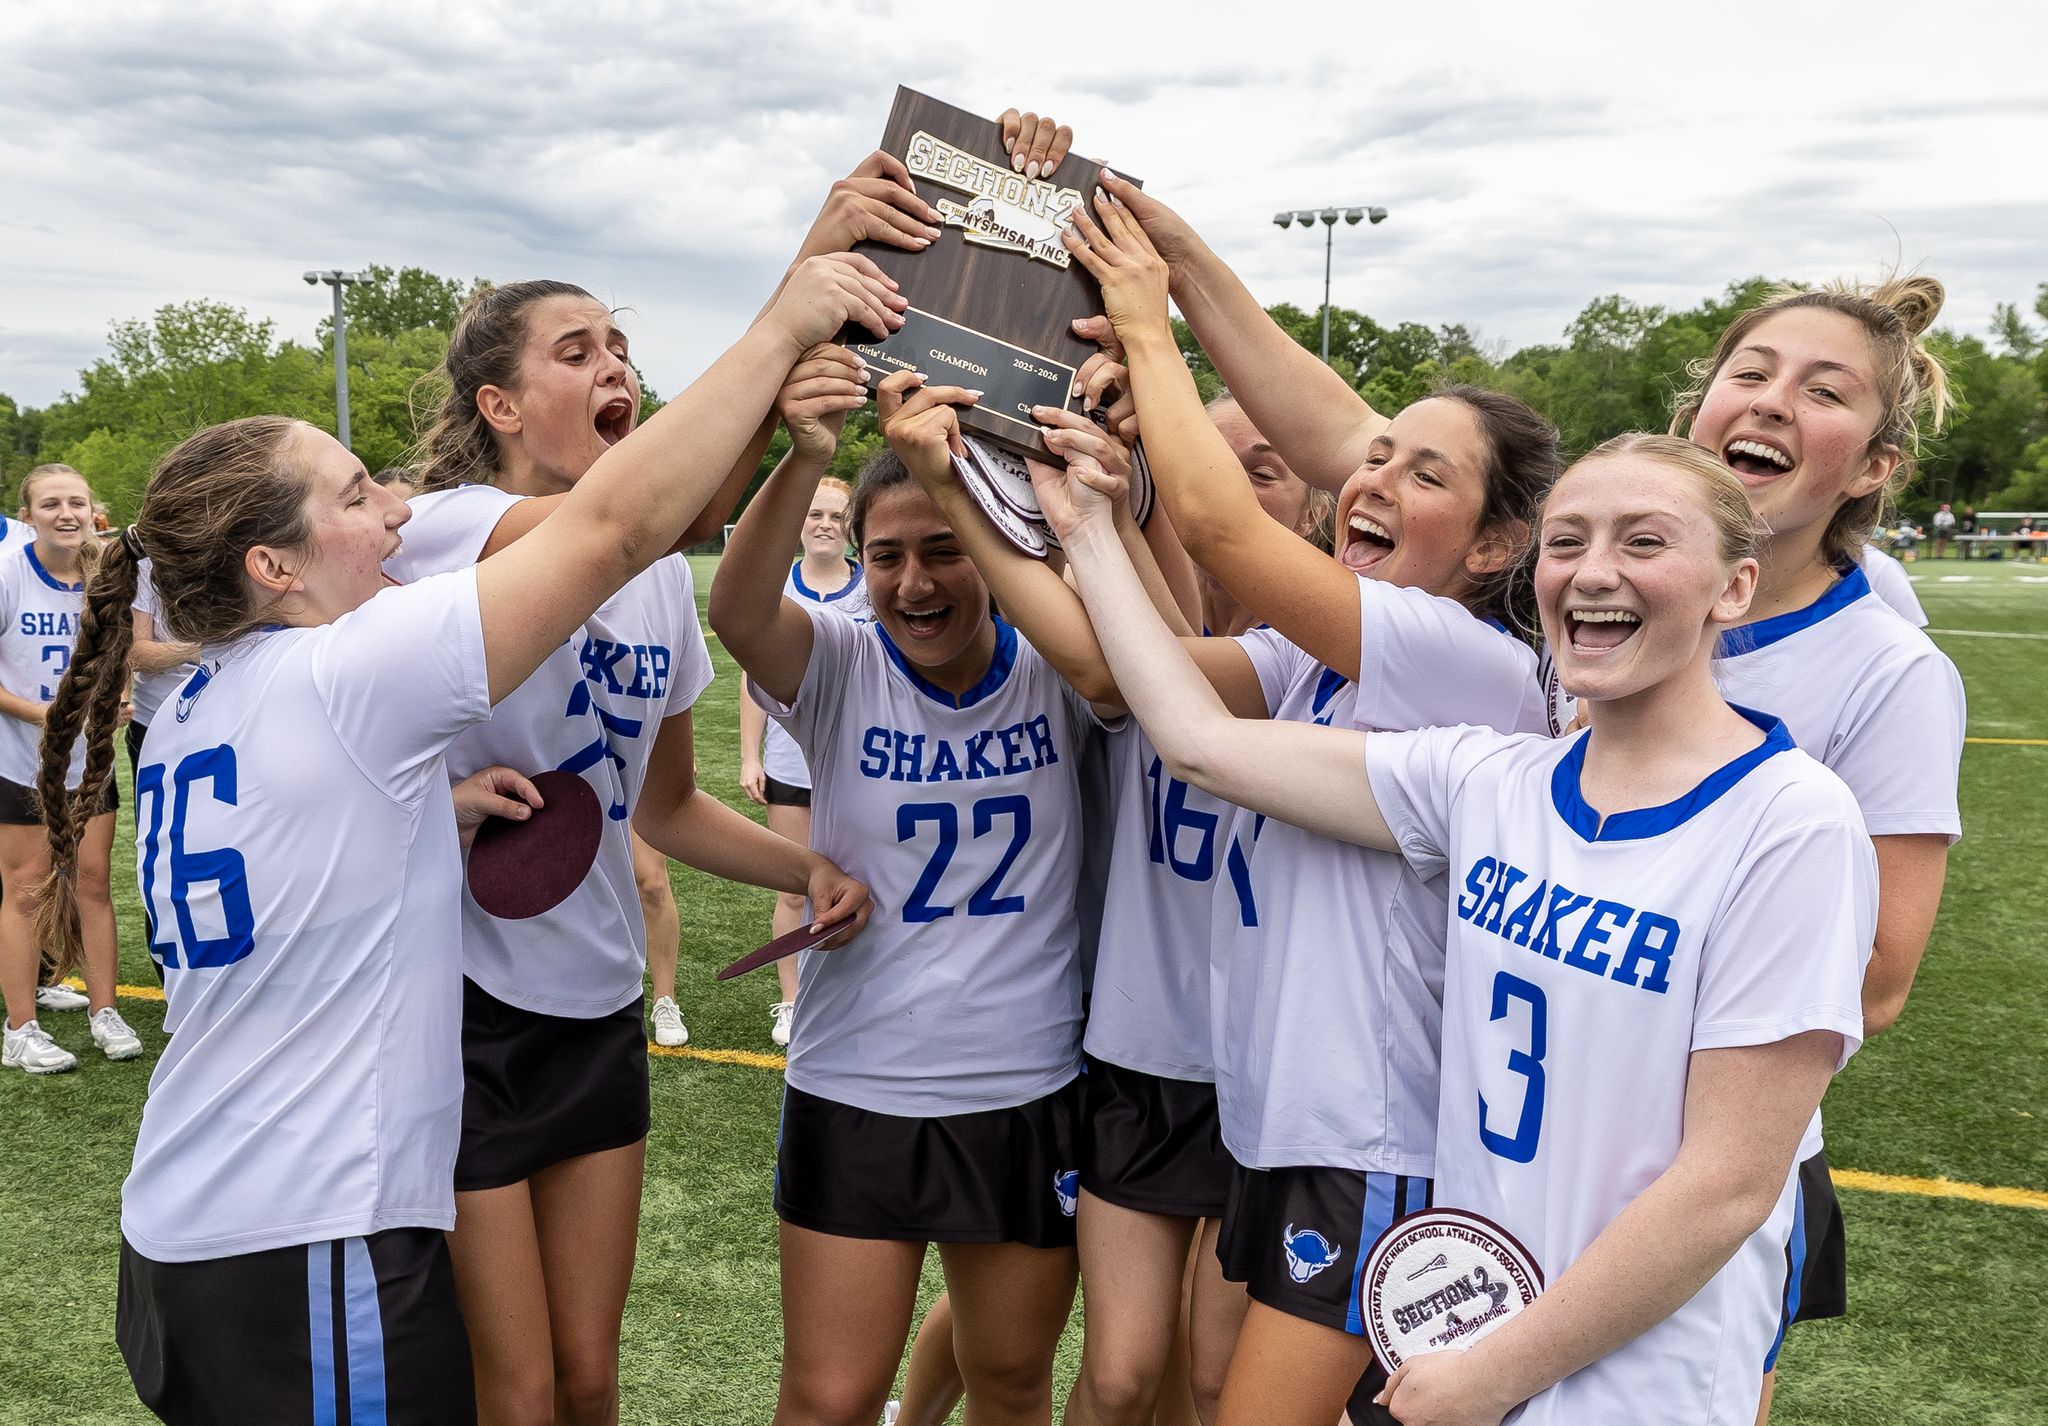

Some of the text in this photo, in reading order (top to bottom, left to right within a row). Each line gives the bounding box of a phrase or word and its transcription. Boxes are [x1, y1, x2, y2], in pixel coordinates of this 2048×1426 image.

[907, 135, 1081, 230] SECTION 2
[881, 352, 918, 373] Lacrosse
[929, 348, 989, 377] CHAMPION
[1017, 402, 1032, 415] Cla
[21, 612, 80, 636] SHA
[40, 645, 70, 701] 3
[578, 638, 671, 699] AKER
[859, 713, 1060, 783] SHAKER
[1148, 755, 1219, 882] 16
[896, 794, 1033, 924] 22
[1458, 856, 1681, 995] SHAKER
[1478, 970, 1547, 1165] 3
[1388, 1239, 1409, 1260] HIGH
[1407, 1227, 1445, 1246] SCHOOL
[1446, 1227, 1493, 1252] ATHLETIC
[1374, 1257, 1394, 1290] PUBLIC
[1373, 1290, 1383, 1320] STATE
[1392, 1266, 1497, 1335] SECTION 2
[1375, 1321, 1392, 1350] YORK
